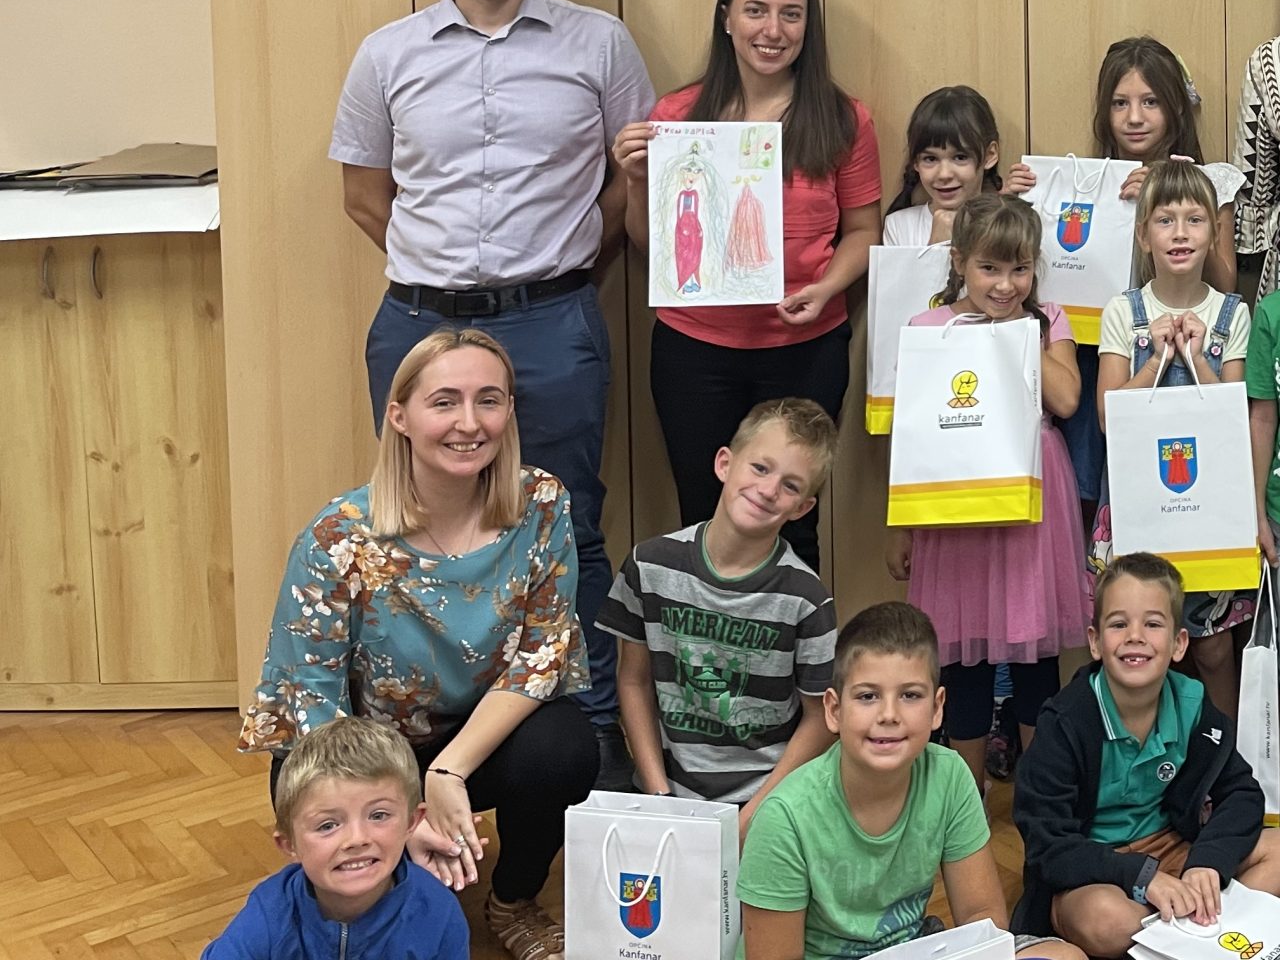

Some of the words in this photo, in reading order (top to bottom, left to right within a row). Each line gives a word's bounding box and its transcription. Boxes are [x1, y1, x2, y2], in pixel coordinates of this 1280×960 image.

[1051, 261, 1086, 271] Kanfanar
[938, 413, 986, 423] kanfanar
[1160, 504, 1201, 513] Kanfanar
[661, 607, 780, 651] AMERICAN
[619, 948, 662, 960] Kanfanar
